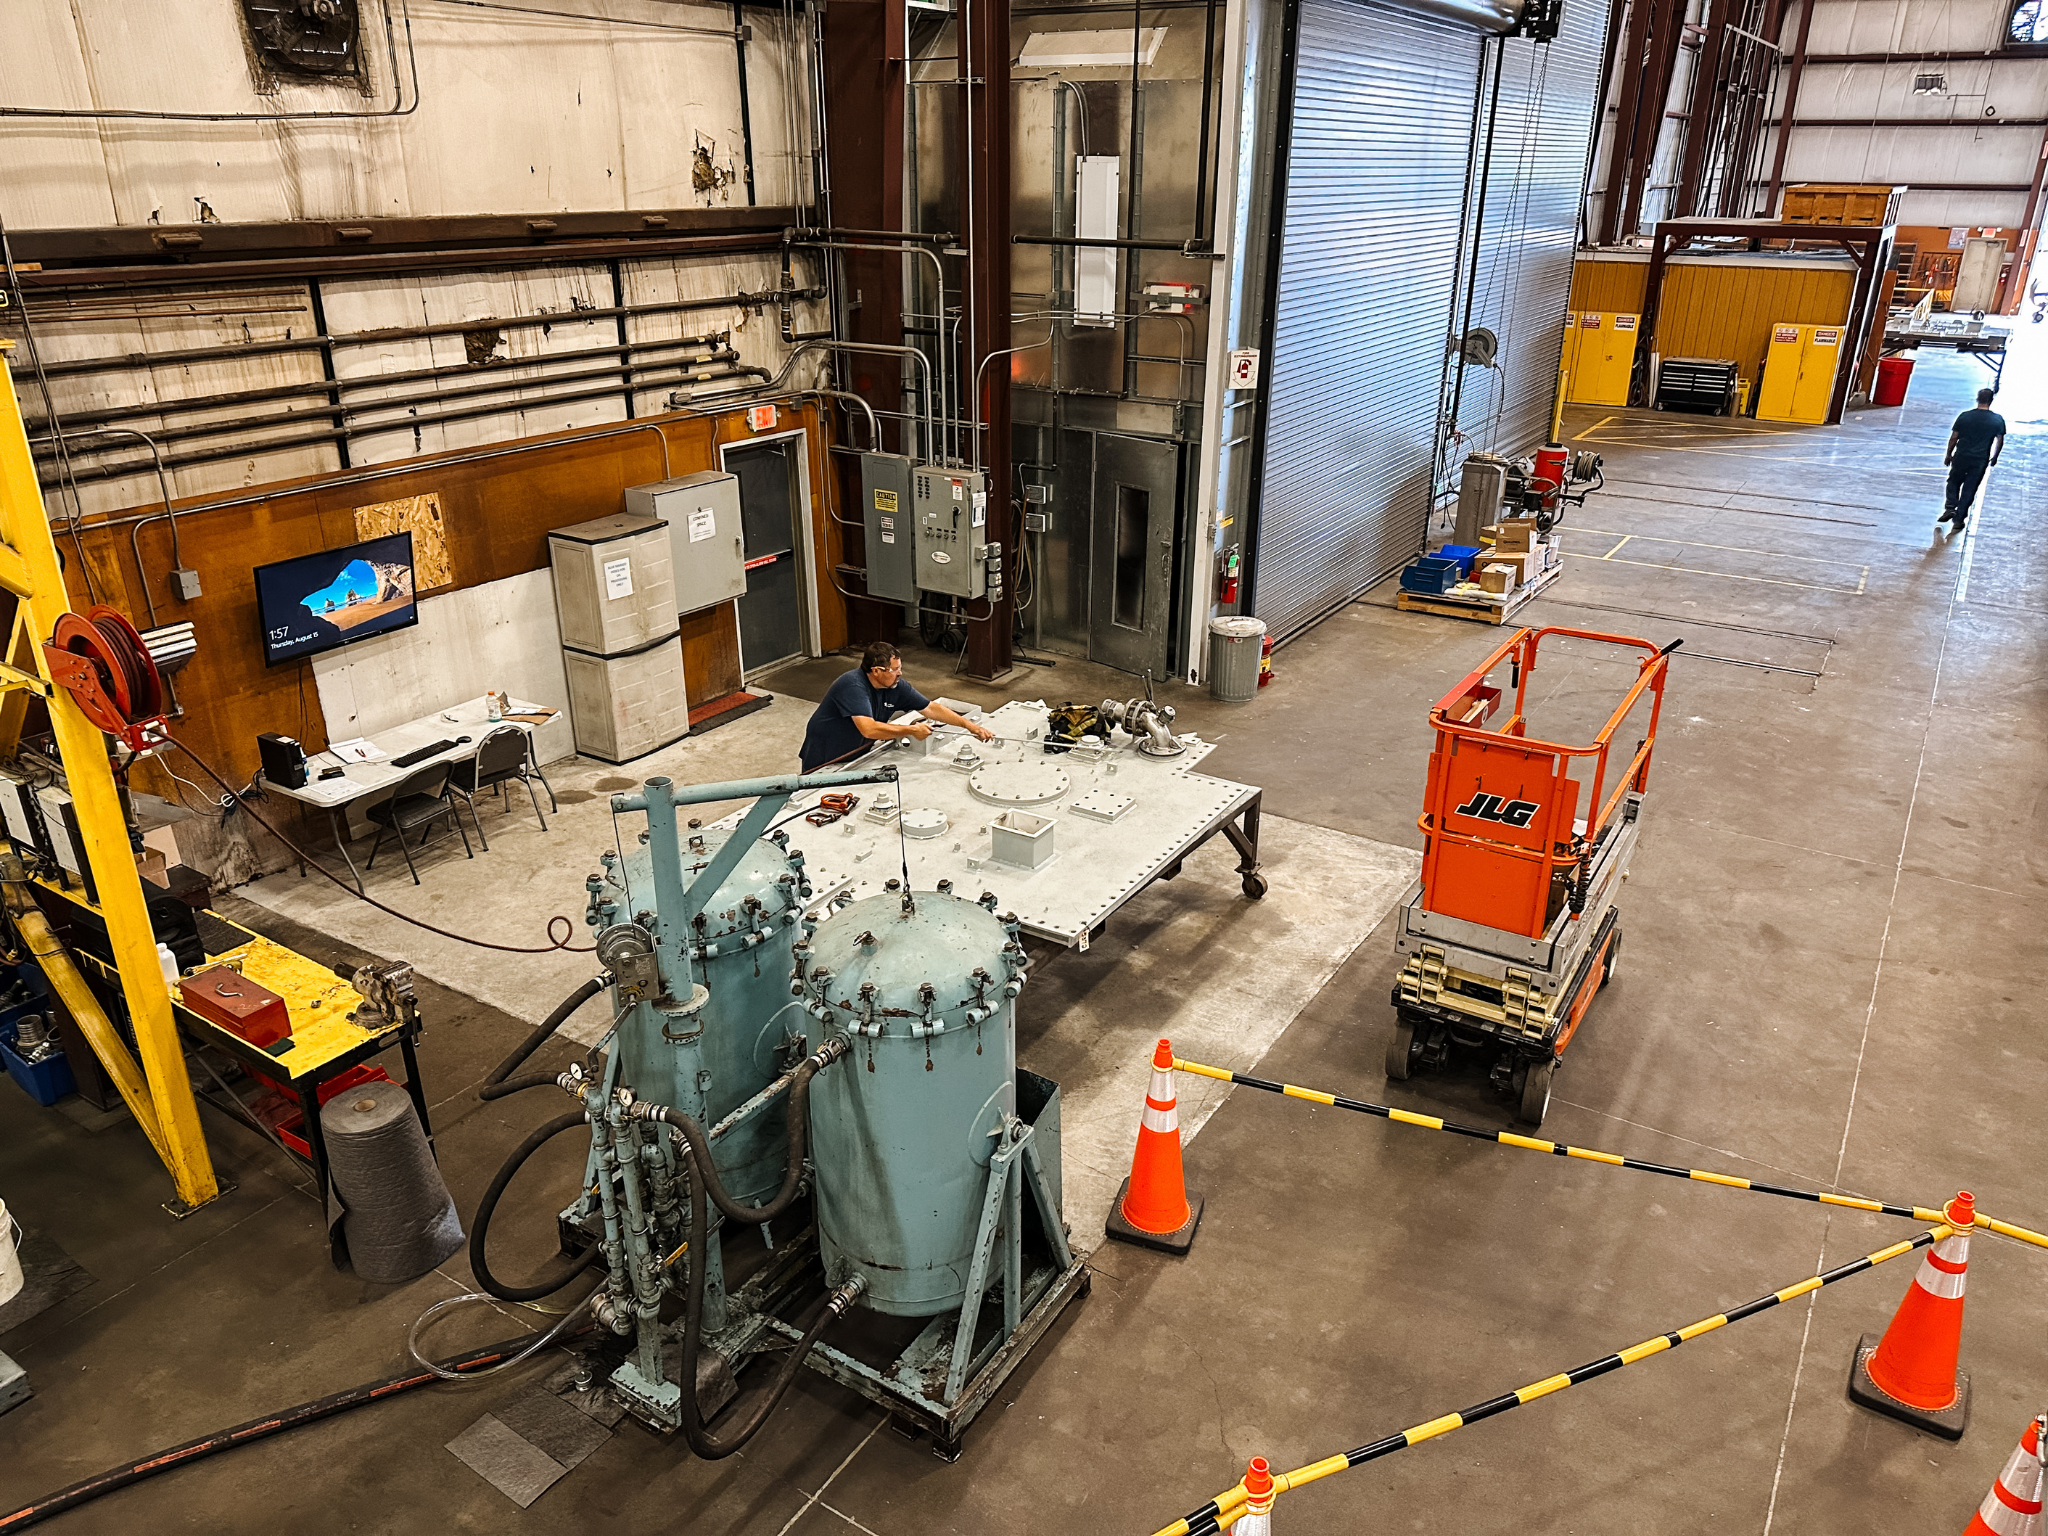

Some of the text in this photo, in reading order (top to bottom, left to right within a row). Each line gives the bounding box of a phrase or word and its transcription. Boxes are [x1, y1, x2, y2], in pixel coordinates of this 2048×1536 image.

[269, 626, 289, 640] 1:57
[270, 640, 294, 649] Thursday,
[296, 634, 312, 642] August
[1454, 791, 1541, 829] JLG
